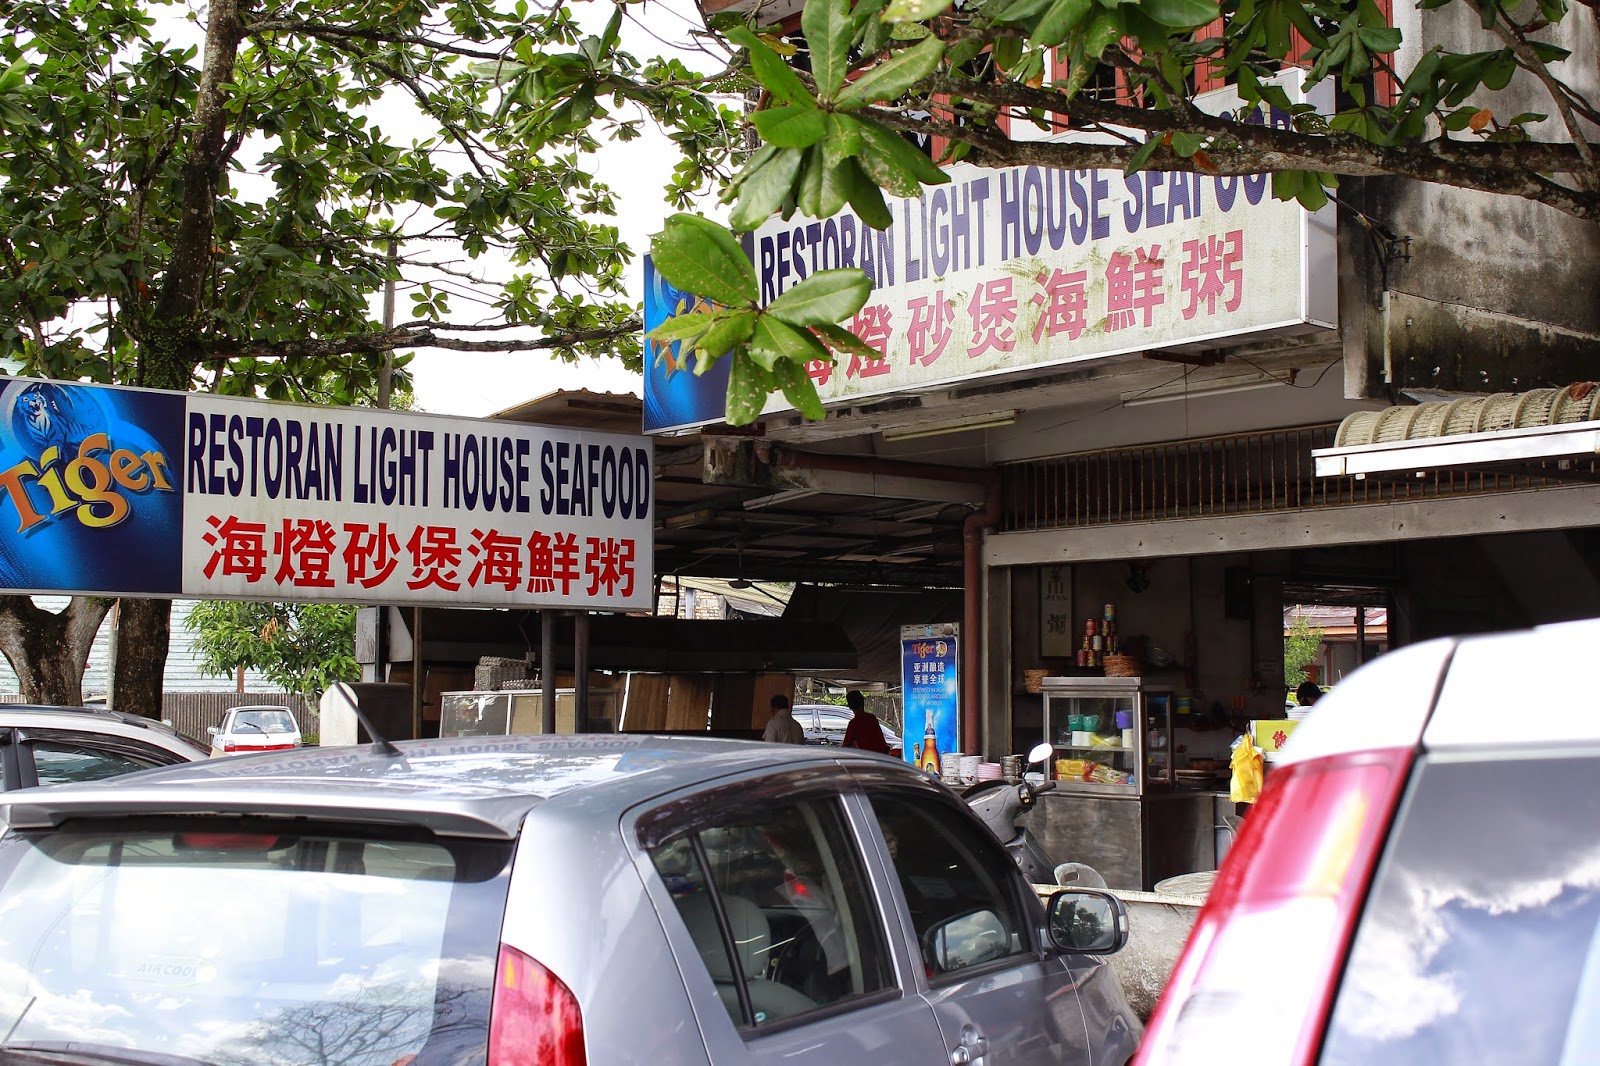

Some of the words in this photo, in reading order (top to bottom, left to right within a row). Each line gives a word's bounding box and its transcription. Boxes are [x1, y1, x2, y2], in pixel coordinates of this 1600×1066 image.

[760, 203, 895, 308] RESTORAN
[905, 177, 989, 283] LIGHT
[1001, 164, 1110, 261] HOUSE
[1122, 102, 1291, 234] SEAO
[0, 433, 174, 534] Tiger
[188, 412, 343, 502] RESTORAN
[353, 425, 434, 507] LIGHT
[443, 432, 530, 513] HOUSE
[540, 439, 649, 520] SEAFOOD
[202, 515, 635, 597] 海燈砂煲海鮮粥
[912, 641, 935, 659] Tiger
